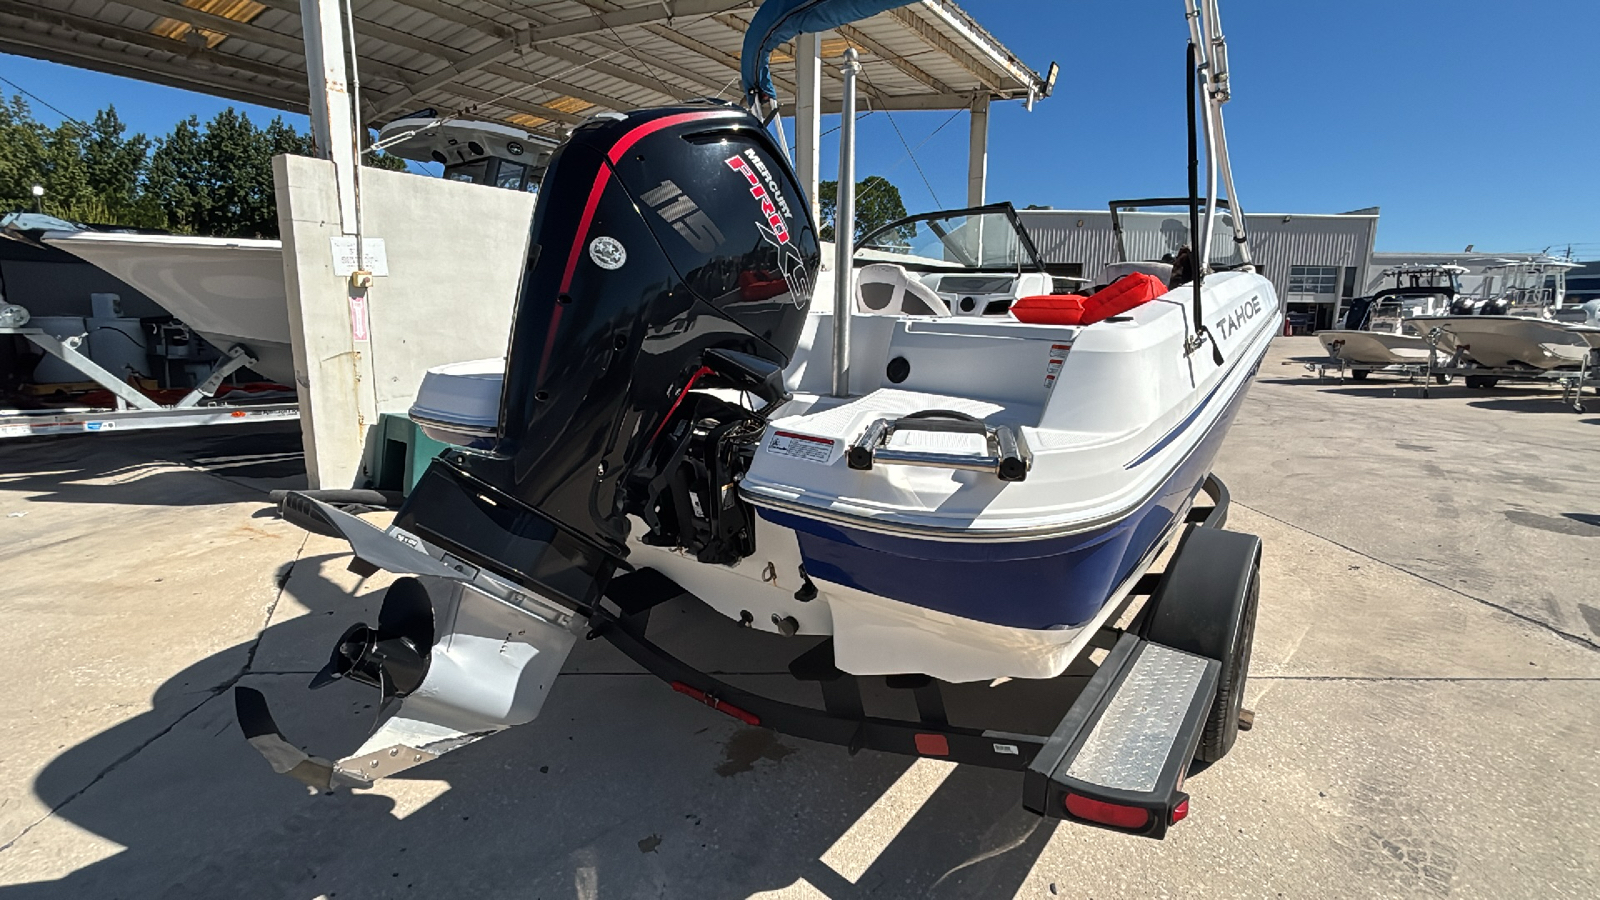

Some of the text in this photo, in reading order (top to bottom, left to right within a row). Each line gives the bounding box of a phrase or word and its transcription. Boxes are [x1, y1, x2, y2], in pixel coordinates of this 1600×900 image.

[639, 179, 726, 254] 115
[743, 148, 793, 219] MERCURY
[724, 154, 812, 311] PRO XS
[1215, 294, 1262, 341] TAHOE
